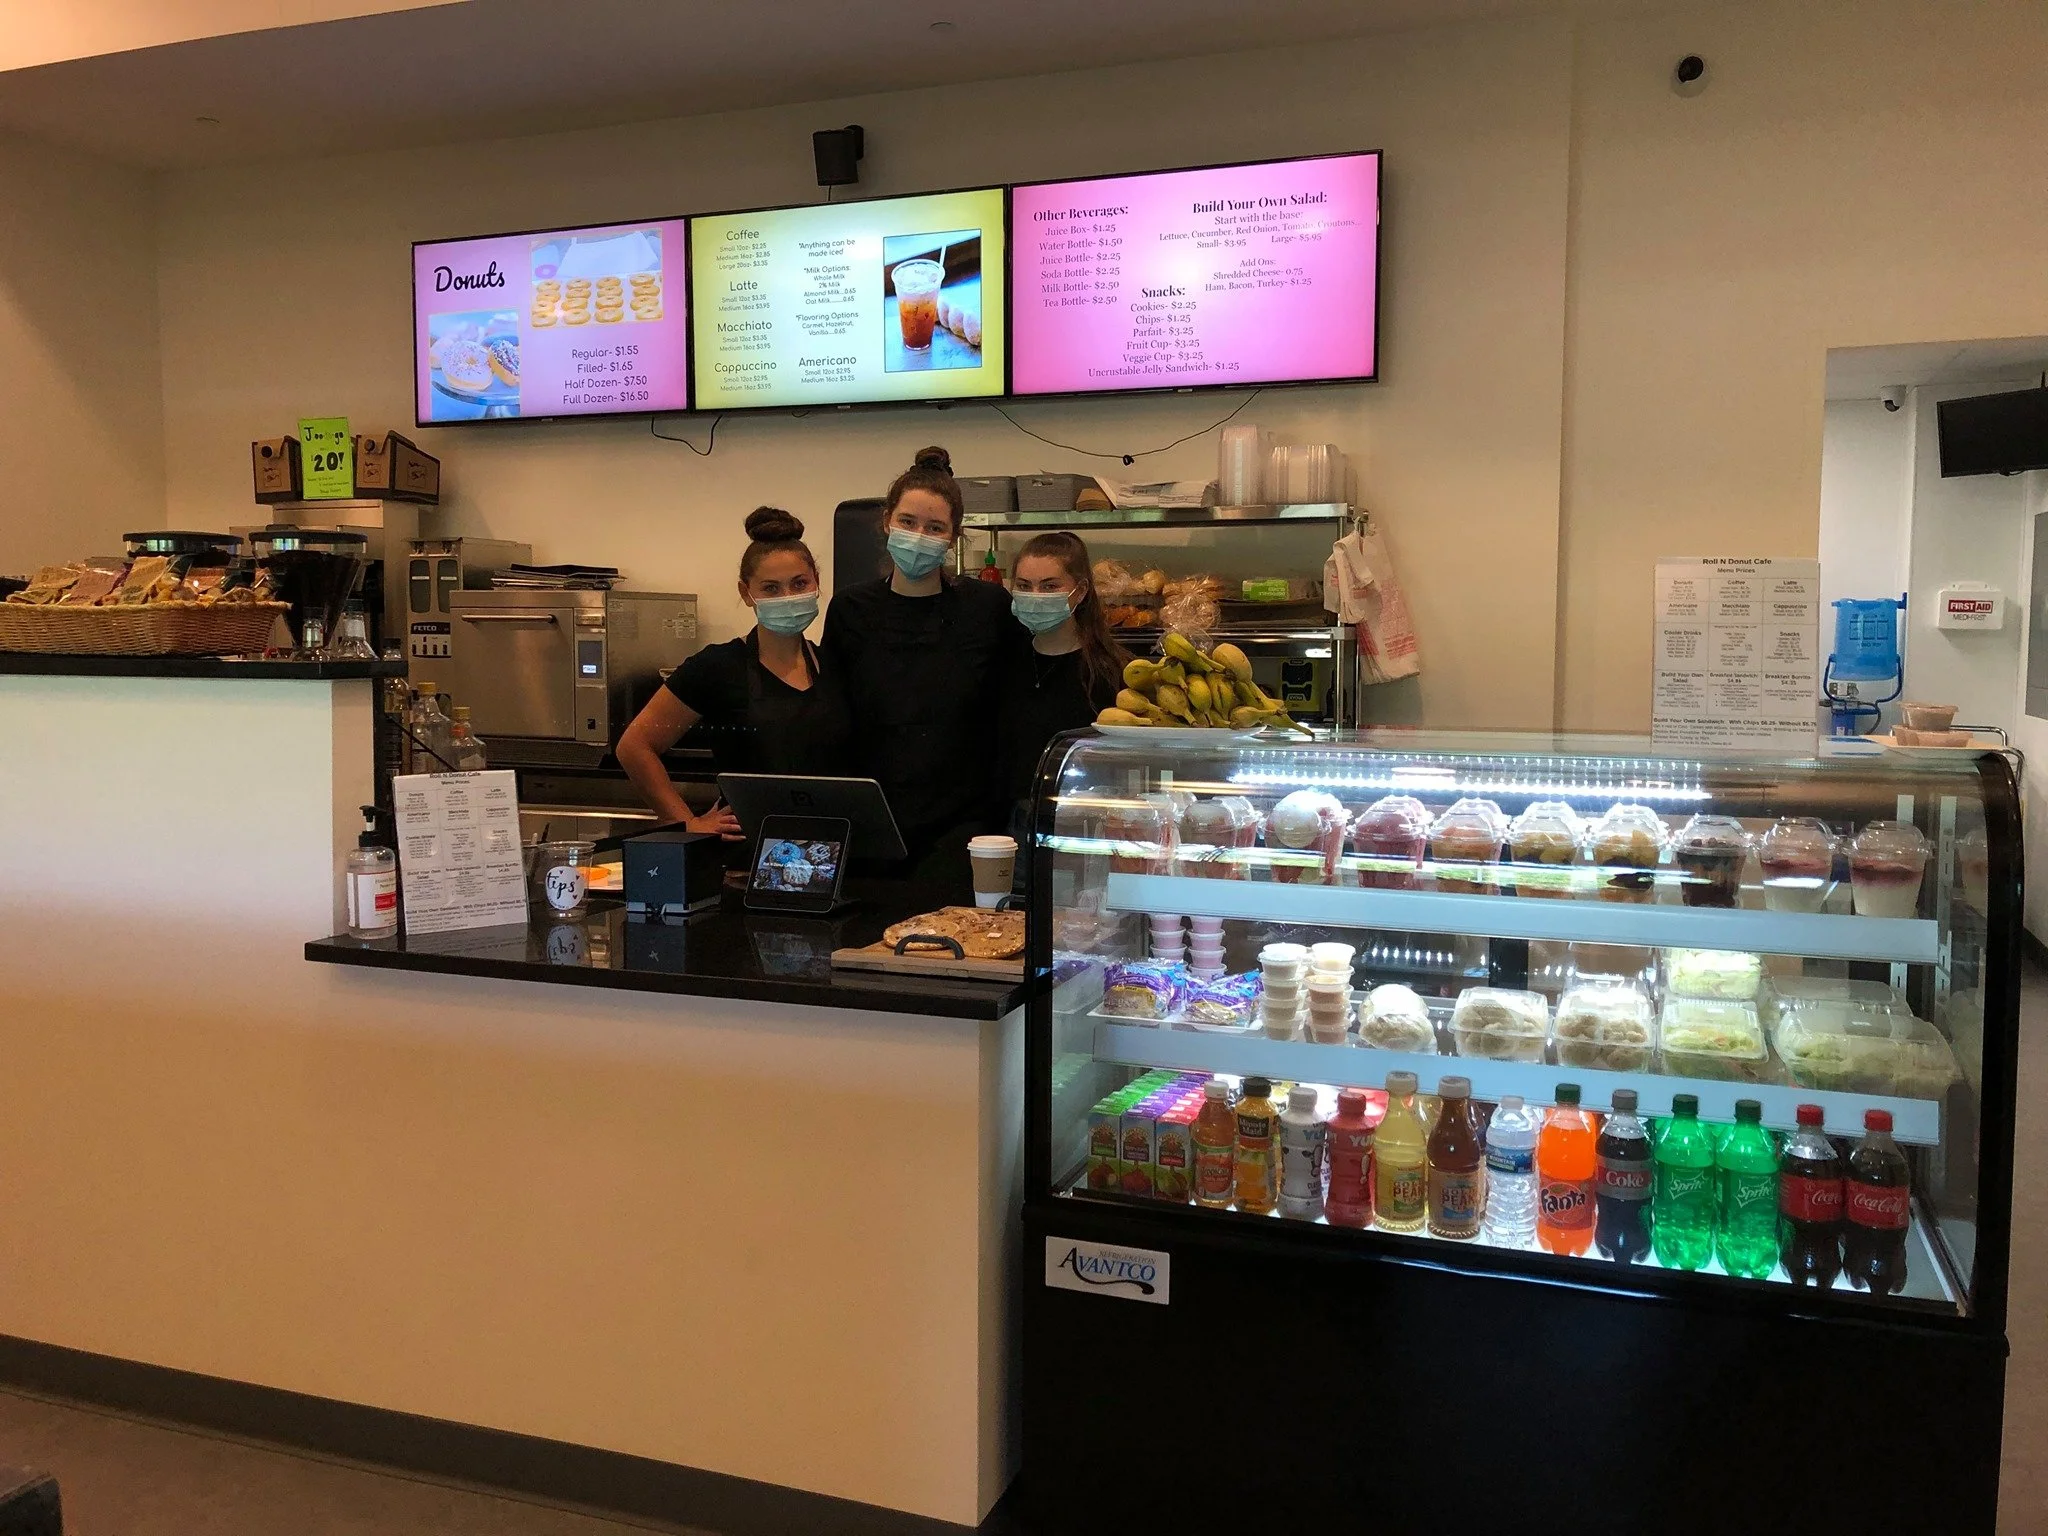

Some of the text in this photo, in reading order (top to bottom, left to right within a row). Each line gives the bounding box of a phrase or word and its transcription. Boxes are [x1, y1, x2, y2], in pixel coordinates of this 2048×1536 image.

[1193, 192, 1327, 213] Build Your Own Salad:
[1034, 205, 1128, 222] Other Beverages:
[1215, 215, 1237, 225] Start
[1239, 214, 1260, 223] with
[1262, 213, 1277, 221] the
[727, 230, 759, 241] Coffee
[1045, 224, 1115, 236] Juice Box- $1.25
[1159, 232, 1190, 241] Lettuce,
[1192, 228, 1233, 239] Cucumber,
[1236, 226, 1251, 235] Red
[1253, 224, 1280, 233] Onion,
[1197, 238, 1247, 249] Small- $3.95
[1271, 233, 1321, 243] Large- $5.95
[1039, 238, 1122, 251] Water Bottle- $1.50
[830, 248, 843, 256] iced
[1040, 253, 1120, 265] Juice Bottle- $2.25
[1240, 258, 1276, 268] Add Ons:
[434, 261, 505, 292] Donuts
[1041, 267, 1120, 279] Soda Bottle- $2.25
[1213, 268, 1303, 280] Shredded Cheese- 0.75
[730, 281, 758, 291] Latte
[1042, 281, 1119, 293] Milk Bottle- $2.50
[1205, 277, 1312, 292] Ham, Bacon, Turkey- $1.25
[1142, 286, 1186, 298] Snacks:
[1043, 296, 1117, 308] Tea Bottle- $2.50
[1131, 301, 1196, 312] Cookies- $2.25
[831, 311, 859, 320] Options
[1136, 314, 1190, 325] Chips- $1.25
[718, 321, 772, 332] Macchiato
[1133, 327, 1193, 337] Parfait- $3.25
[1127, 339, 1200, 350] Fruit Cup- $3.25
[572, 345, 639, 360] Regular- $1.55
[1123, 351, 1204, 364] Veggie Cup- $3.25
[577, 361, 633, 374] Filled- $1.65
[715, 361, 777, 374] Cappuccino
[799, 356, 857, 367] Americano
[1088, 362, 1239, 378] Uncrustable Jelly Sandwich- $1.25
[565, 375, 647, 389] Half Dozen- $7.50
[801, 376, 824, 384] Medium
[563, 390, 649, 404] Full Dozen- $16.50
[1950, 602, 1991, 611] FIRST AID
[547, 873, 575, 899] tips
[1606, 1171, 1644, 1186] Coke
[1670, 1179, 1705, 1192] Sprite
[1738, 1184, 1774, 1200] Sprite
[1541, 1189, 1586, 1214] Fanta
[1059, 1247, 1155, 1282] AVANTCO
